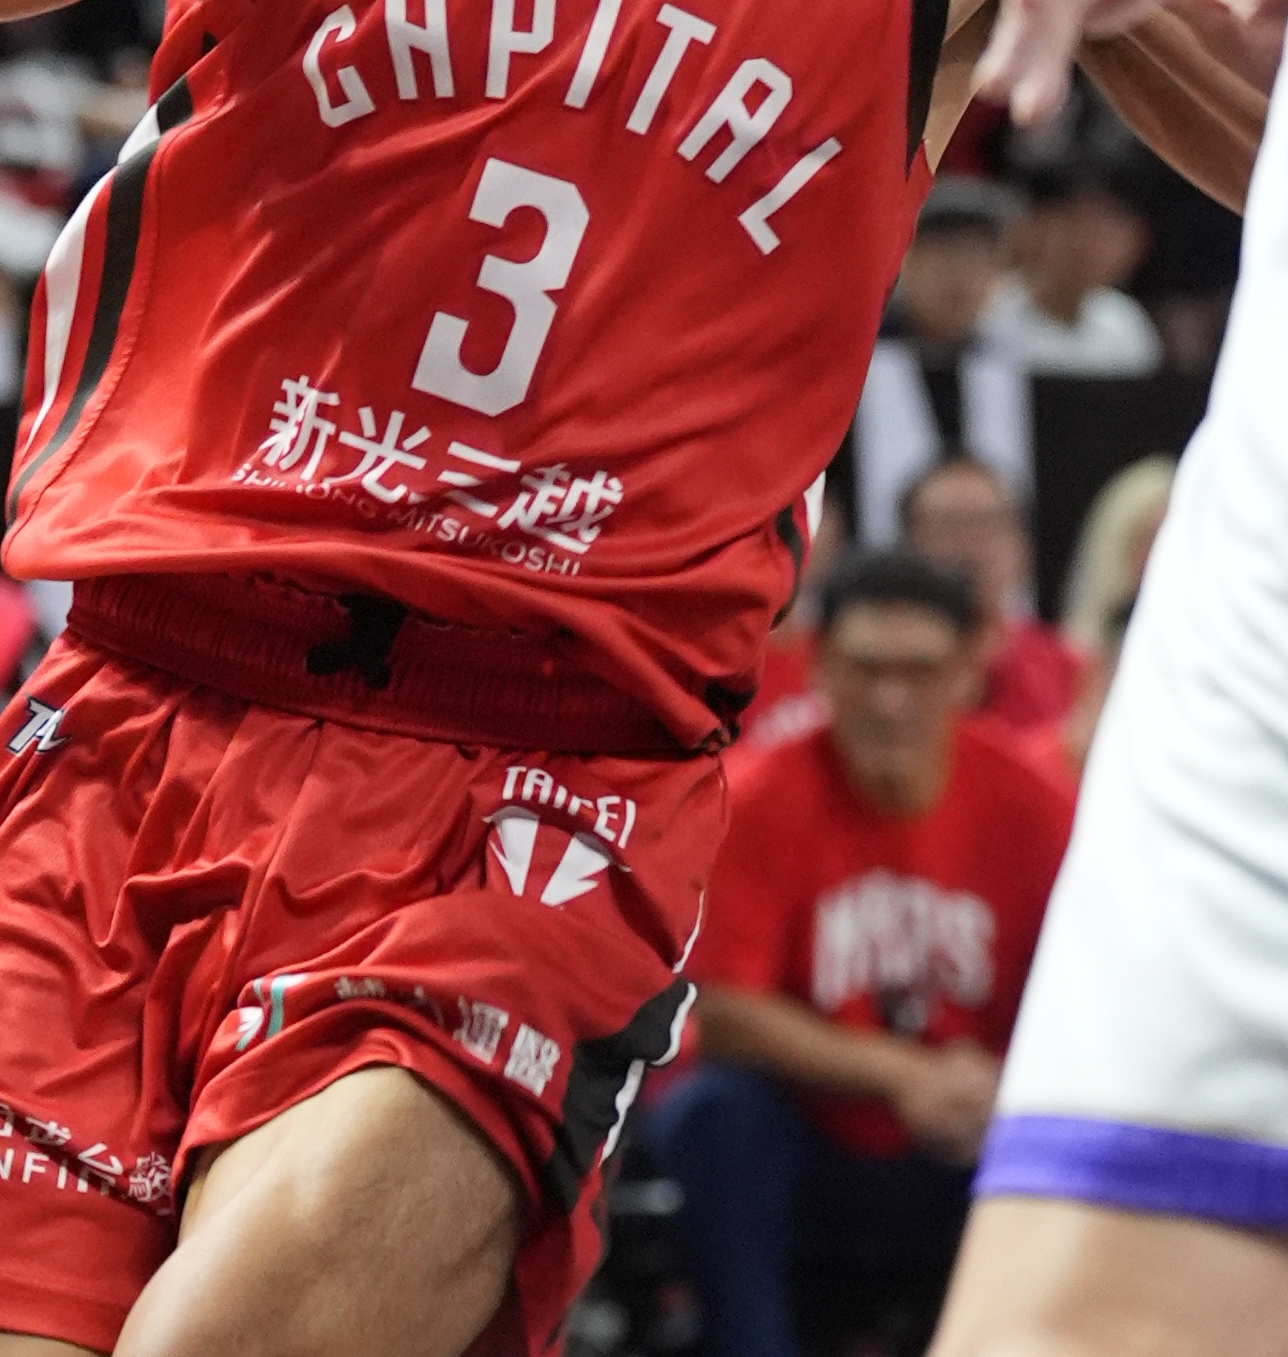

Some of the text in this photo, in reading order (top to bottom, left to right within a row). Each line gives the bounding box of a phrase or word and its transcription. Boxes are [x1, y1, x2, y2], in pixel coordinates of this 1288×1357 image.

[412, 157, 590, 416] 3
[259, 375, 624, 555] 新光三越
